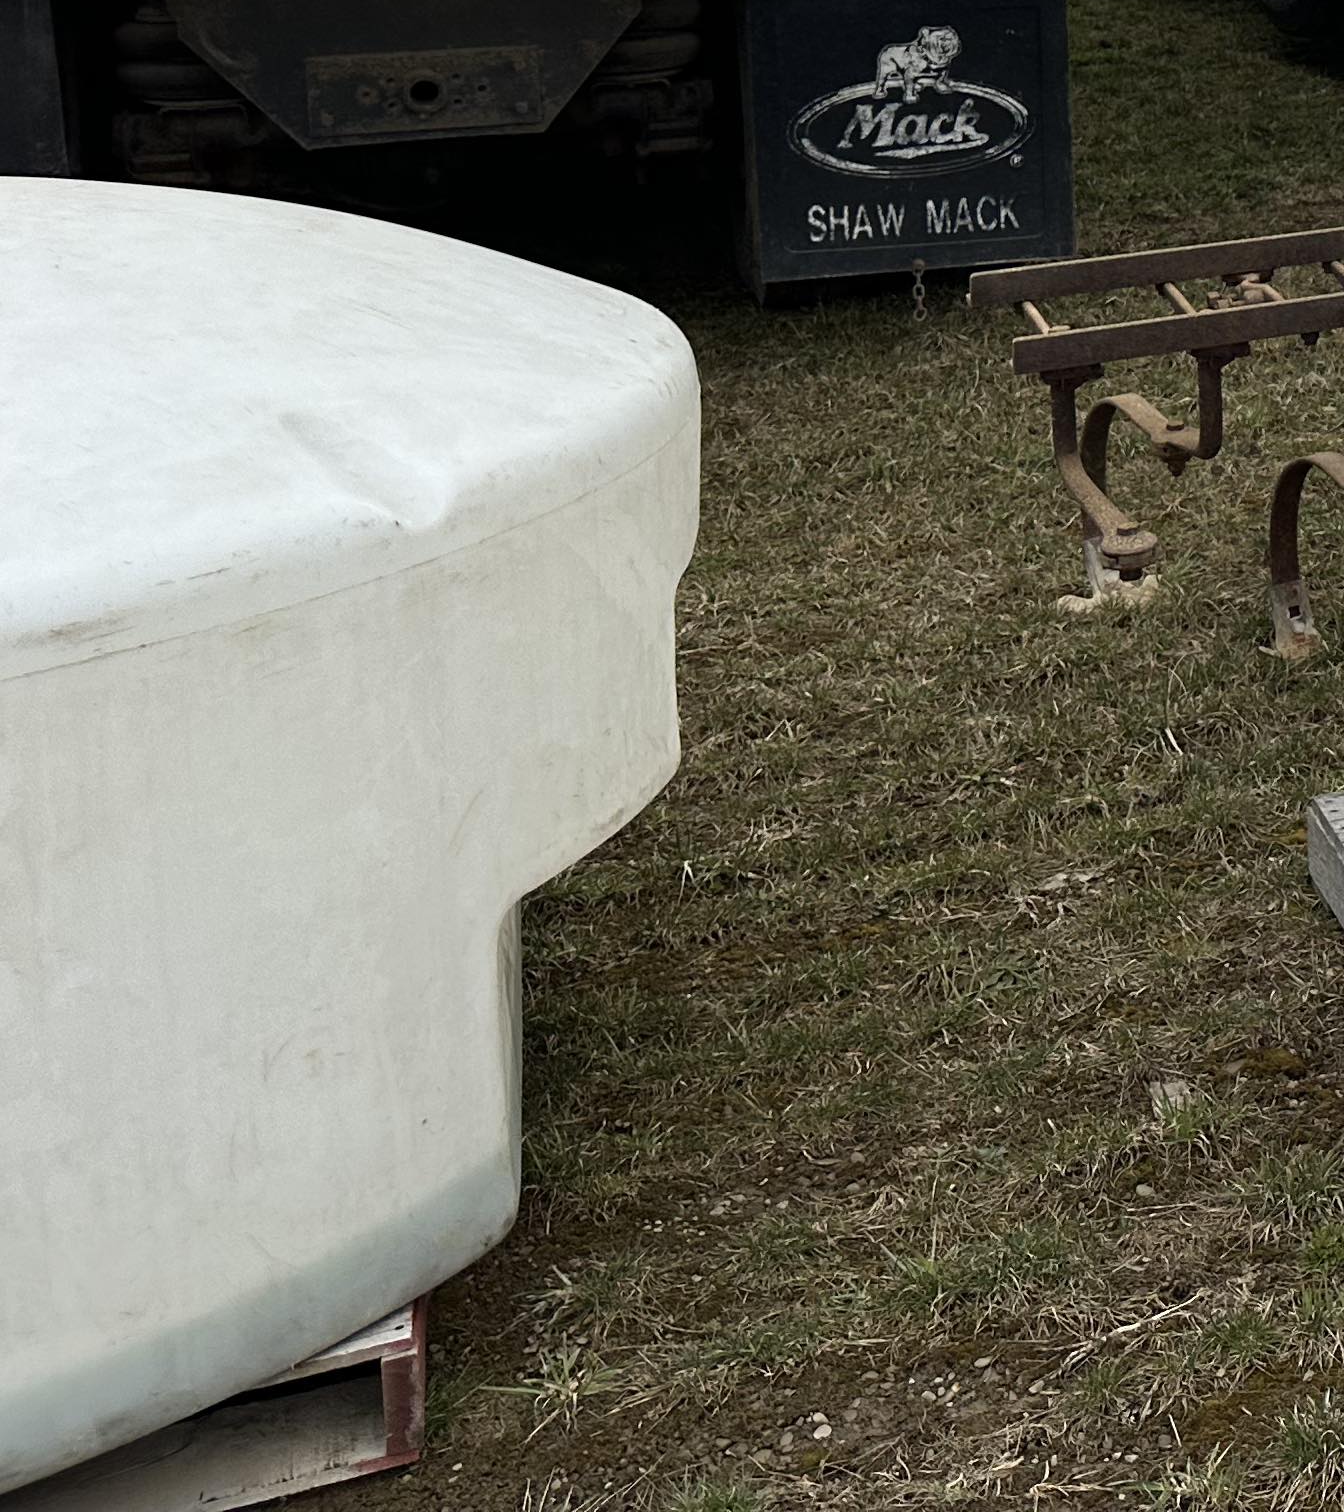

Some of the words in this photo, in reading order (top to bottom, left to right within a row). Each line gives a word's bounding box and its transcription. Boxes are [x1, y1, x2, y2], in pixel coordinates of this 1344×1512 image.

[837, 97, 990, 155] Mack
[807, 202, 906, 243] SHAW
[926, 195, 1020, 234] MACK
